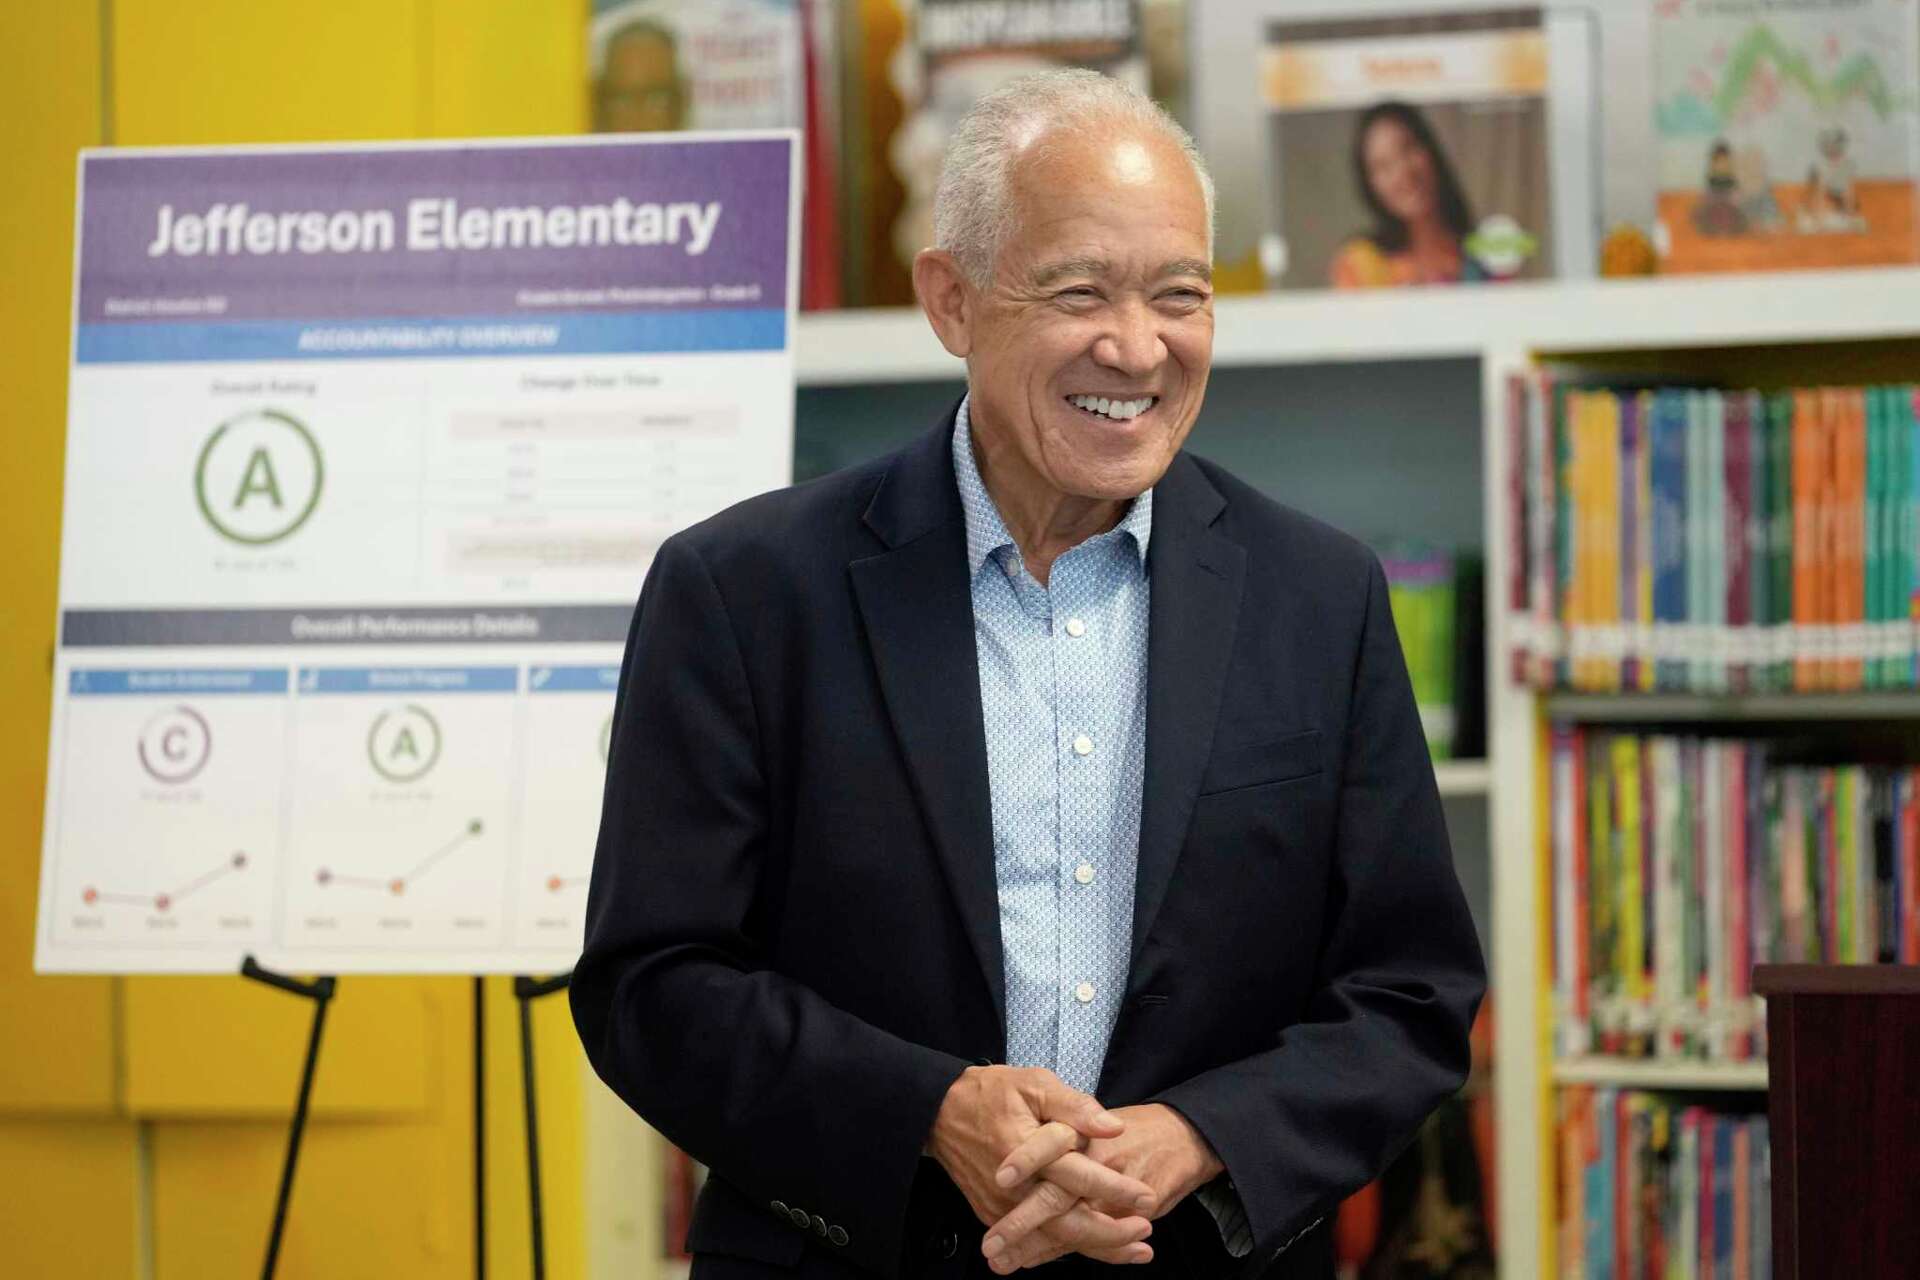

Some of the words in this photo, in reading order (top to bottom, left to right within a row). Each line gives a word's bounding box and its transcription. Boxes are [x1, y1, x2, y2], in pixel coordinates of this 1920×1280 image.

[148, 202, 395, 257] Jefferson
[407, 197, 722, 256] Elementary
[232, 446, 283, 510] A
[162, 725, 188, 762] C
[389, 725, 420, 760] A
